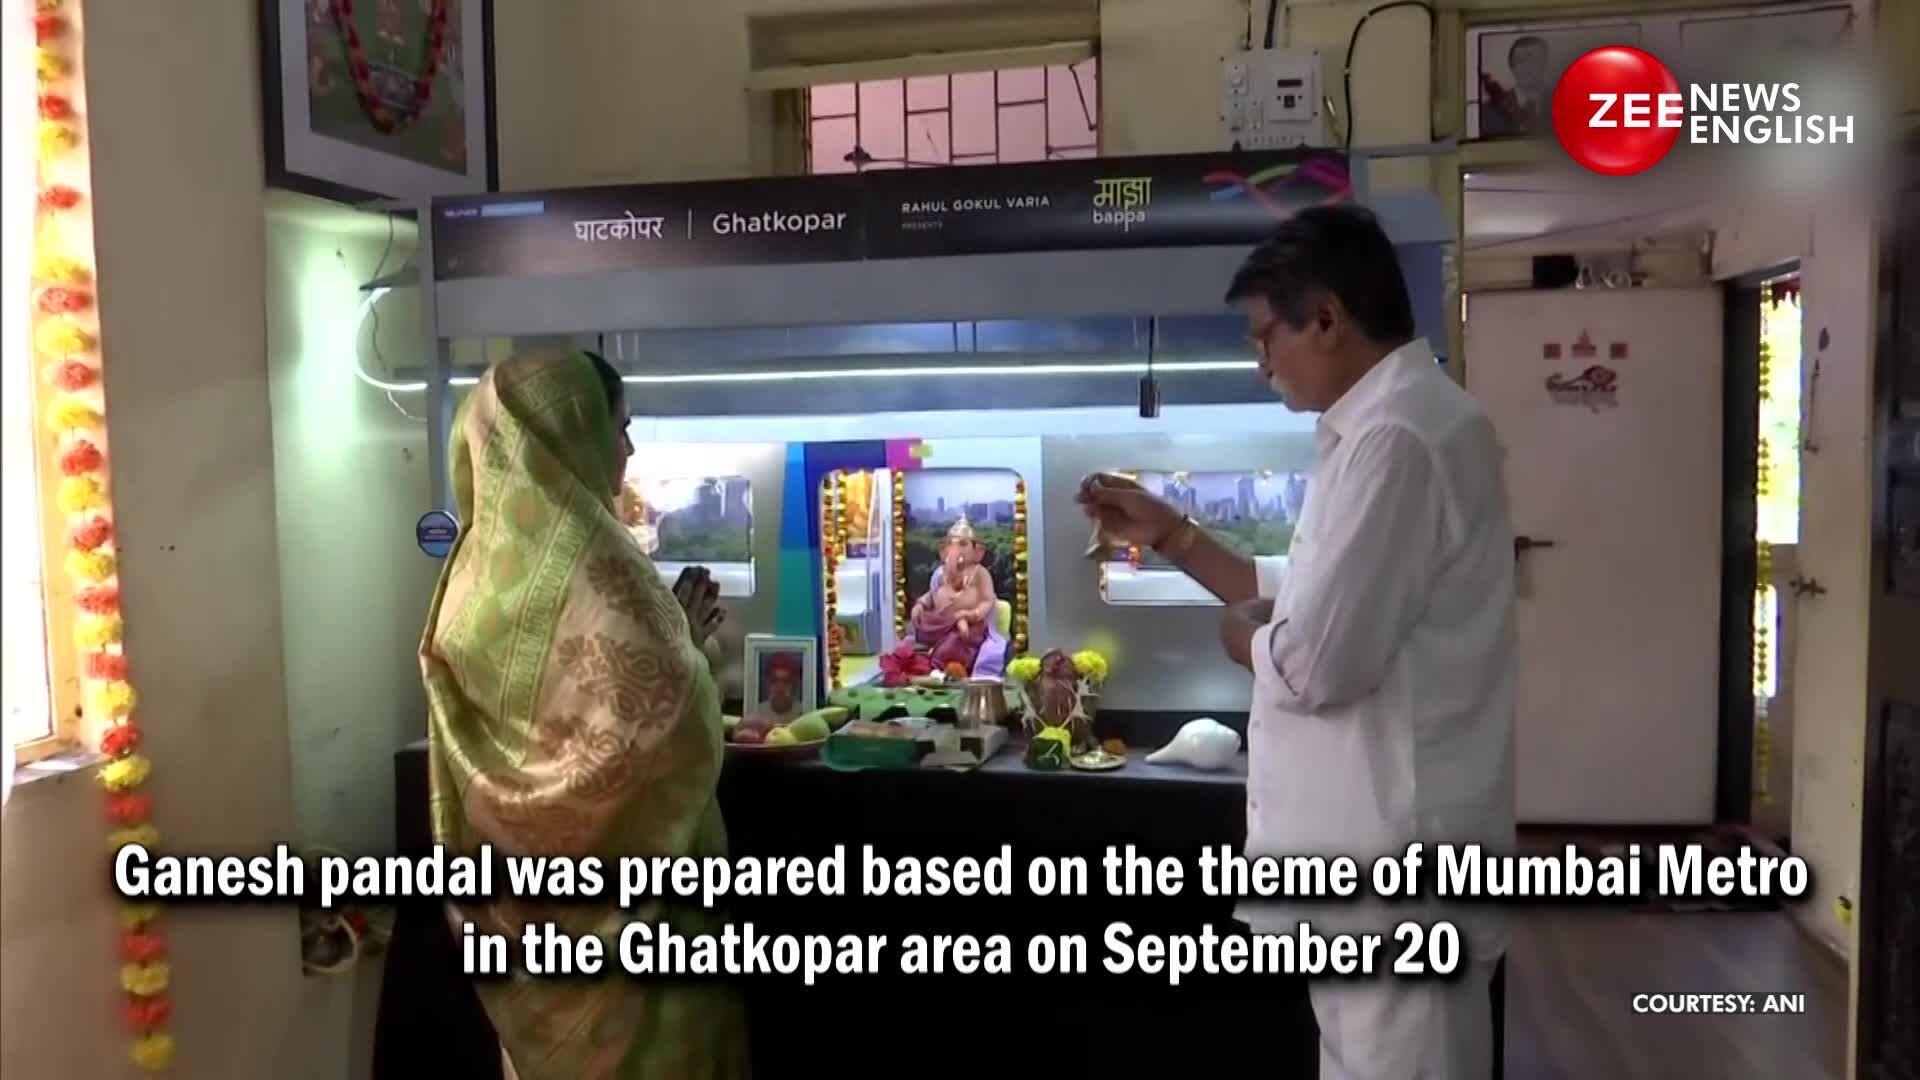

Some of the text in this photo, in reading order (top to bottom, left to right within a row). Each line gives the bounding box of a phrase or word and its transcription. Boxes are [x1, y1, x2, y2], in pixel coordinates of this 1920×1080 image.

[901, 195, 1050, 213] RAHUL GOKUL VARIA
[573, 211, 665, 243] घाटकोपर
[712, 210, 847, 236] Ghatkopar
[1093, 208, 1146, 232] bappa
